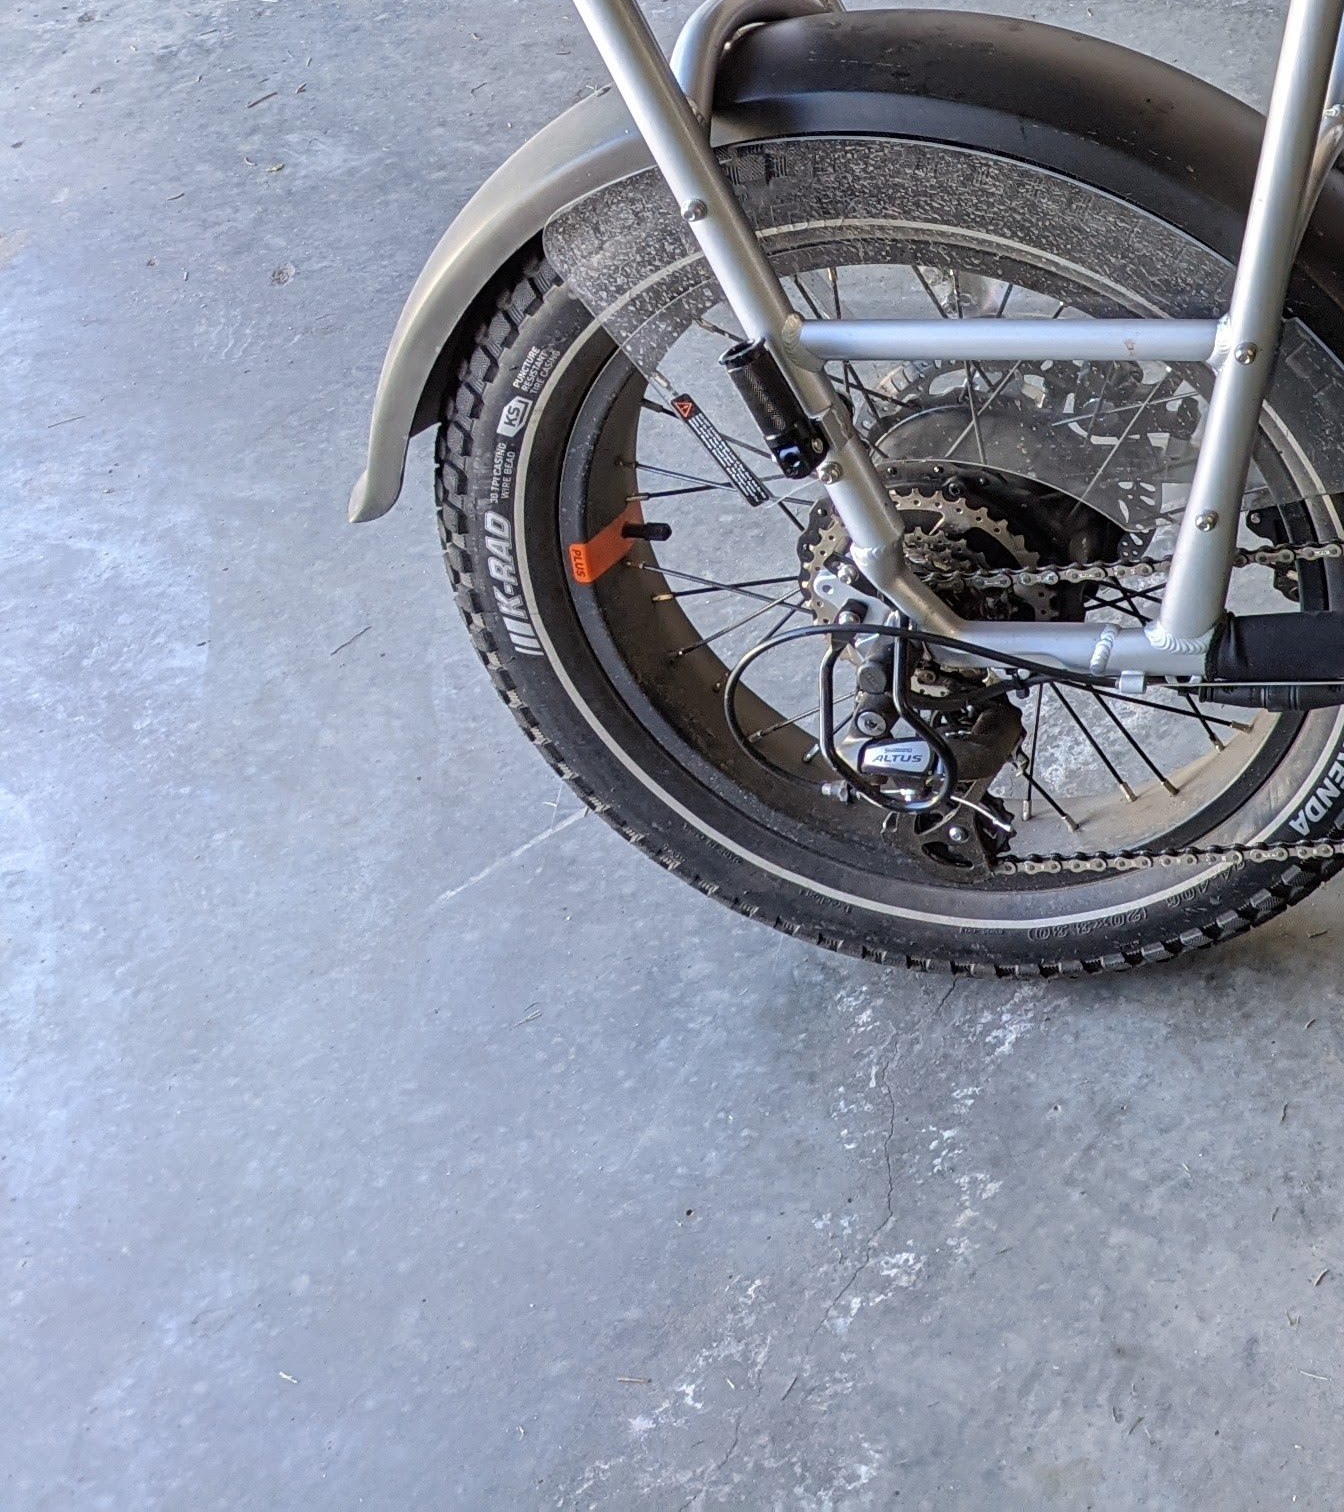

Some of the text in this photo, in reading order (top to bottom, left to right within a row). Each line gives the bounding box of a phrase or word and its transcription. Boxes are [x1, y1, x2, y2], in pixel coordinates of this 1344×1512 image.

[512, 346, 541, 389] PUNCTURE
[521, 350, 549, 393] RESISTANT
[529, 349, 561, 395] TIRE CASING
[493, 442, 507, 476] CASING
[501, 450, 516, 501] WIRE BEAD
[485, 510, 529, 620] K-RAD
[572, 548, 586, 577] PLUS
[872, 754, 923, 763] ALTUS
